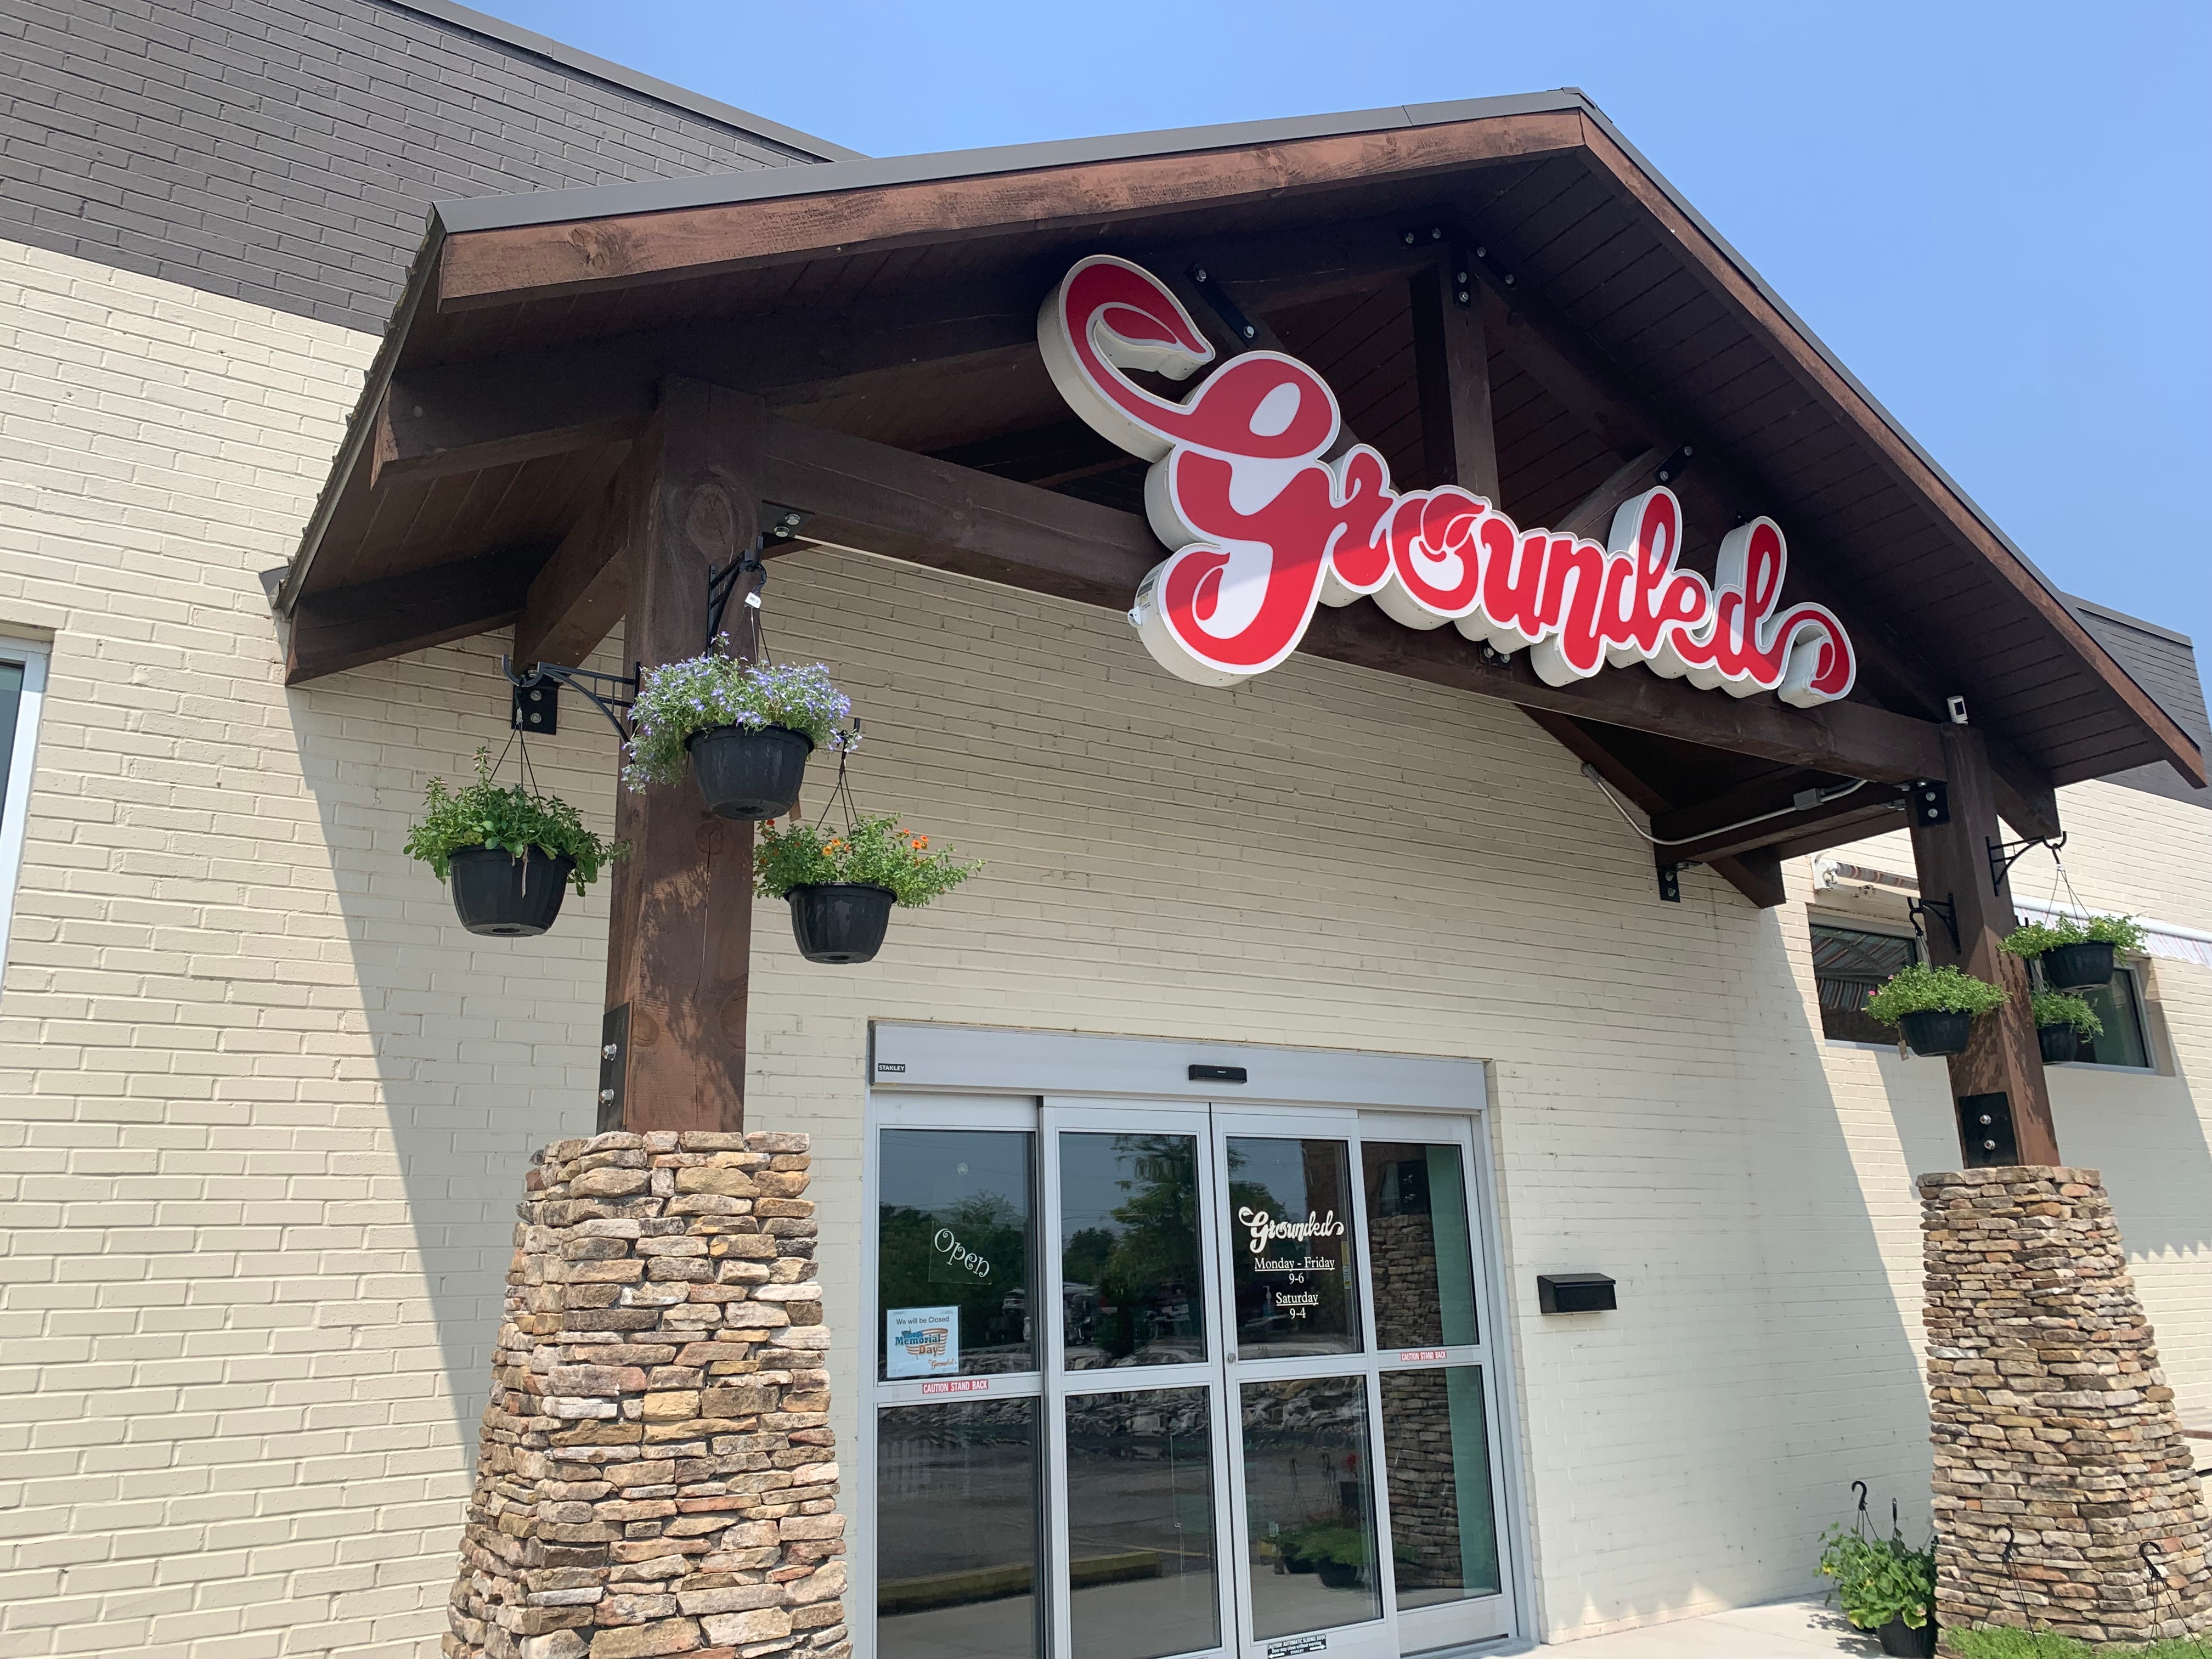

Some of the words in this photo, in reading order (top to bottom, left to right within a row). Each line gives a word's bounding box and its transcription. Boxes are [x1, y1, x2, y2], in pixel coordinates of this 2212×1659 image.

[1064, 263, 1852, 693] Grounded
[1238, 1206, 1344, 1253] Grounded
[934, 1228, 990, 1278] Open
[1254, 1257, 1294, 1272] Monday
[1304, 1257, 1335, 1271] Friday
[1289, 1272, 1305, 1284] 9-6
[1276, 1291, 1318, 1306] Saturday
[1289, 1307, 1306, 1320] 9-4
[895, 1334, 940, 1346] Memorial
[918, 1345, 939, 1357] Day
[1402, 1353, 1419, 1361] CAUTION
[1420, 1352, 1434, 1360] STAND
[1435, 1351, 1446, 1359] BACK
[923, 1383, 949, 1393] CAUTION
[951, 1381, 970, 1391] STAND
[972, 1380, 988, 1390] BACK
